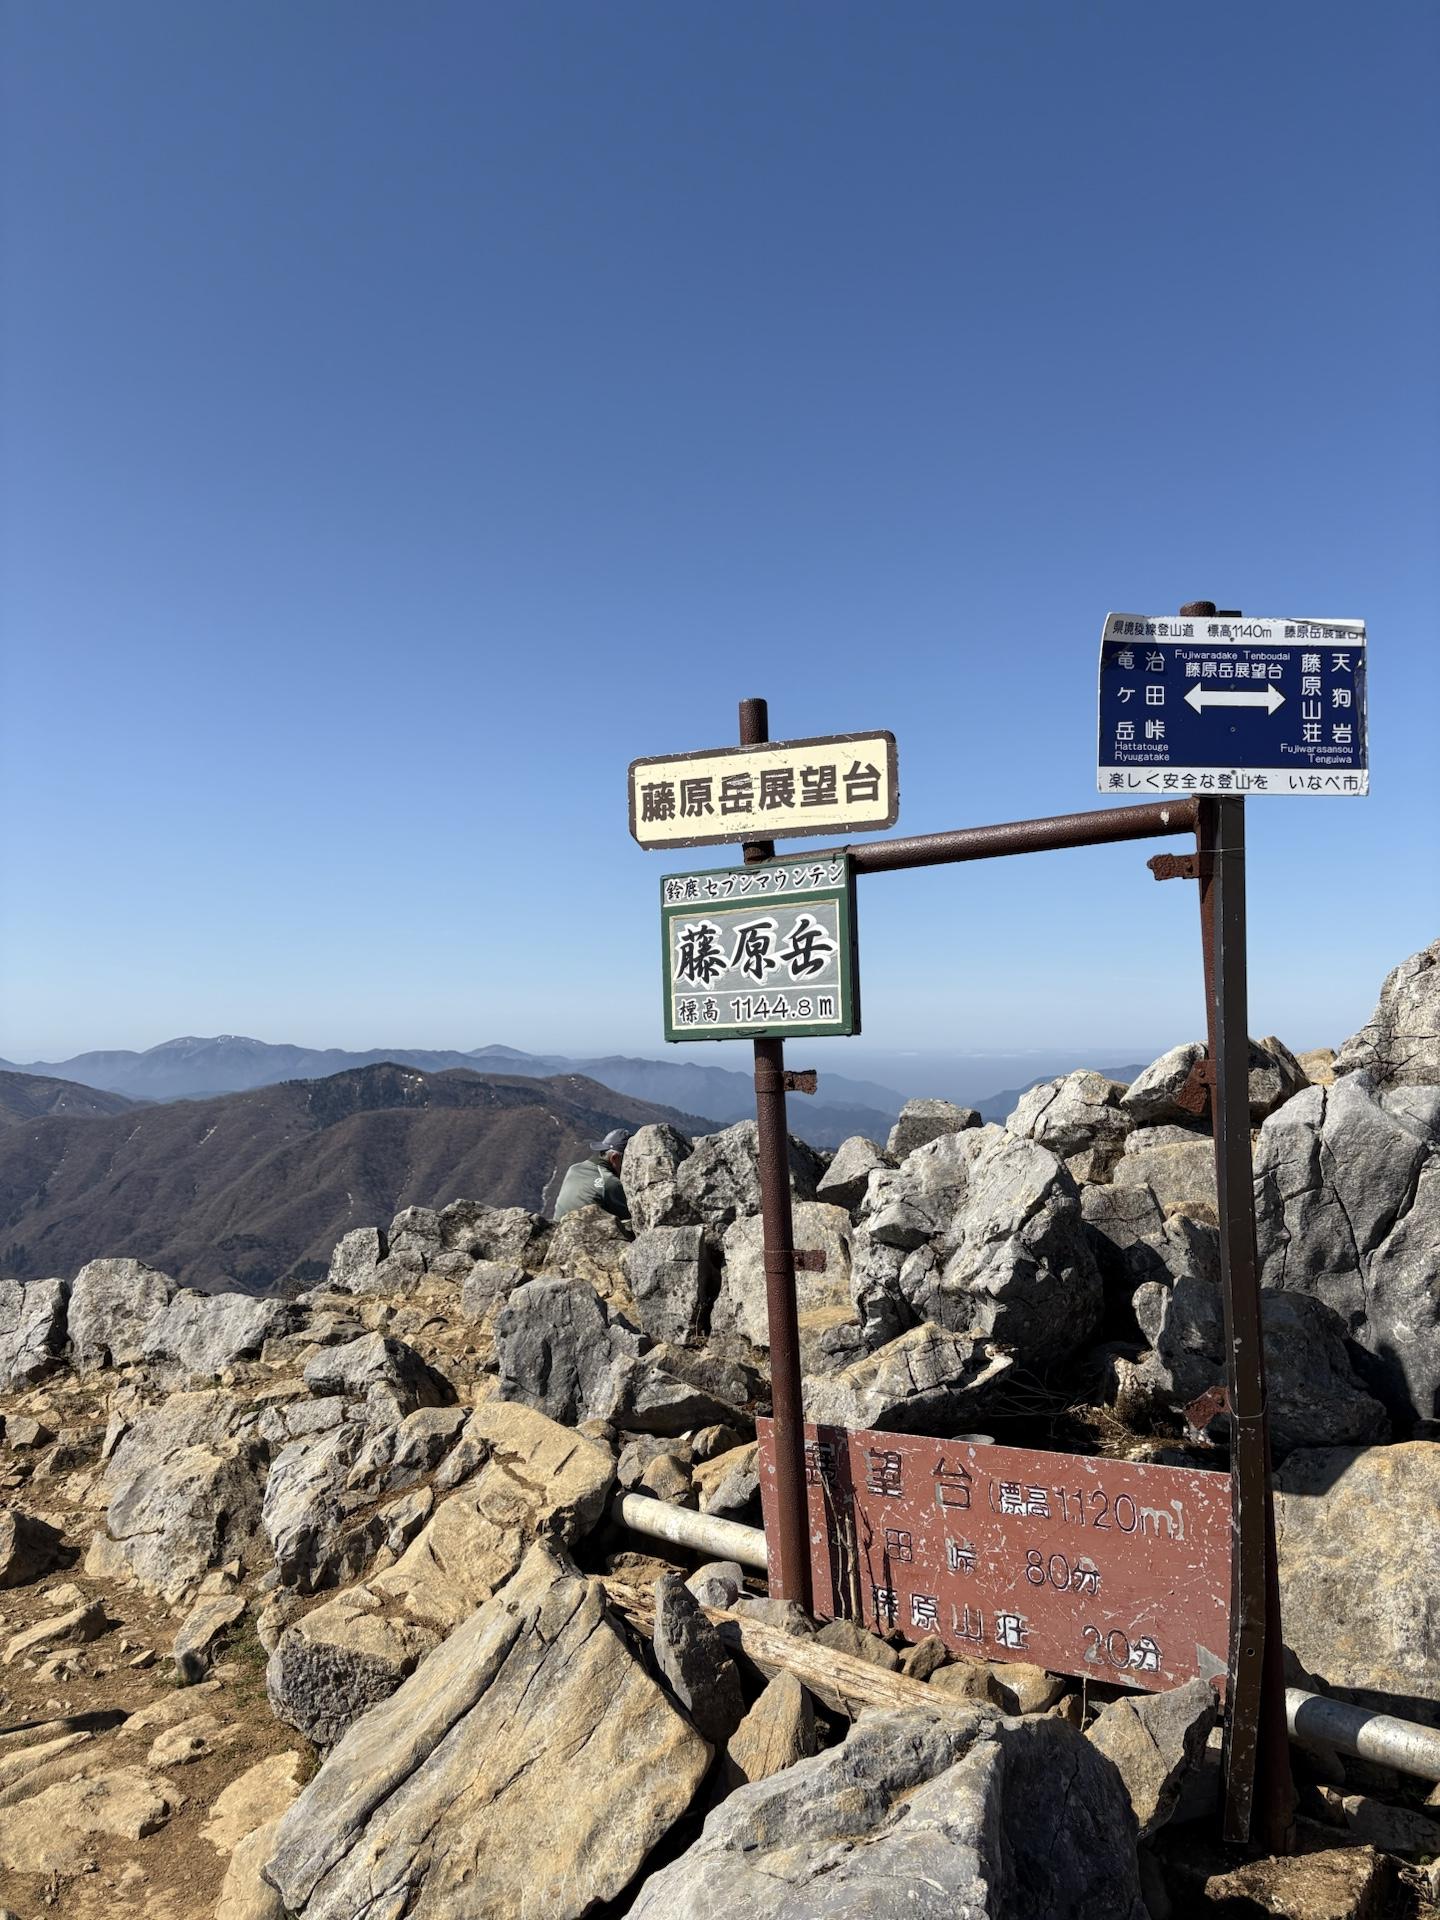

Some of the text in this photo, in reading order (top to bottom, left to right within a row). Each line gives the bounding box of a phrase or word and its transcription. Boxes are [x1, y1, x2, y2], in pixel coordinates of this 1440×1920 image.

[1207, 624, 1272, 638] 標高1140m
[1174, 649, 1291, 661] Fujiwaradake Tenboudai
[1185, 661, 1284, 679] 藤原岳展望台
[1145, 651, 1166, 741] 治田峠
[1301, 653, 1322, 743] 藤原山荘
[1331, 653, 1352, 744] 天狗岩
[1114, 741, 1169, 752] Hattatouge
[1114, 751, 1170, 762] Ryuugatake
[1280, 743, 1354, 754] Fujiwarasansou
[1308, 753, 1353, 764] Tenguiwa
[640, 760, 882, 823] 藤原岳展望台
[1109, 773, 1361, 791] 楽しく安全な登山を いなべ市
[666, 863, 844, 900] 鈴鹿 セブンマウンテン
[676, 918, 834, 985] 藤原岳
[679, 999, 719, 1024] 標高
[1081, 1624, 1163, 1673] 20分
